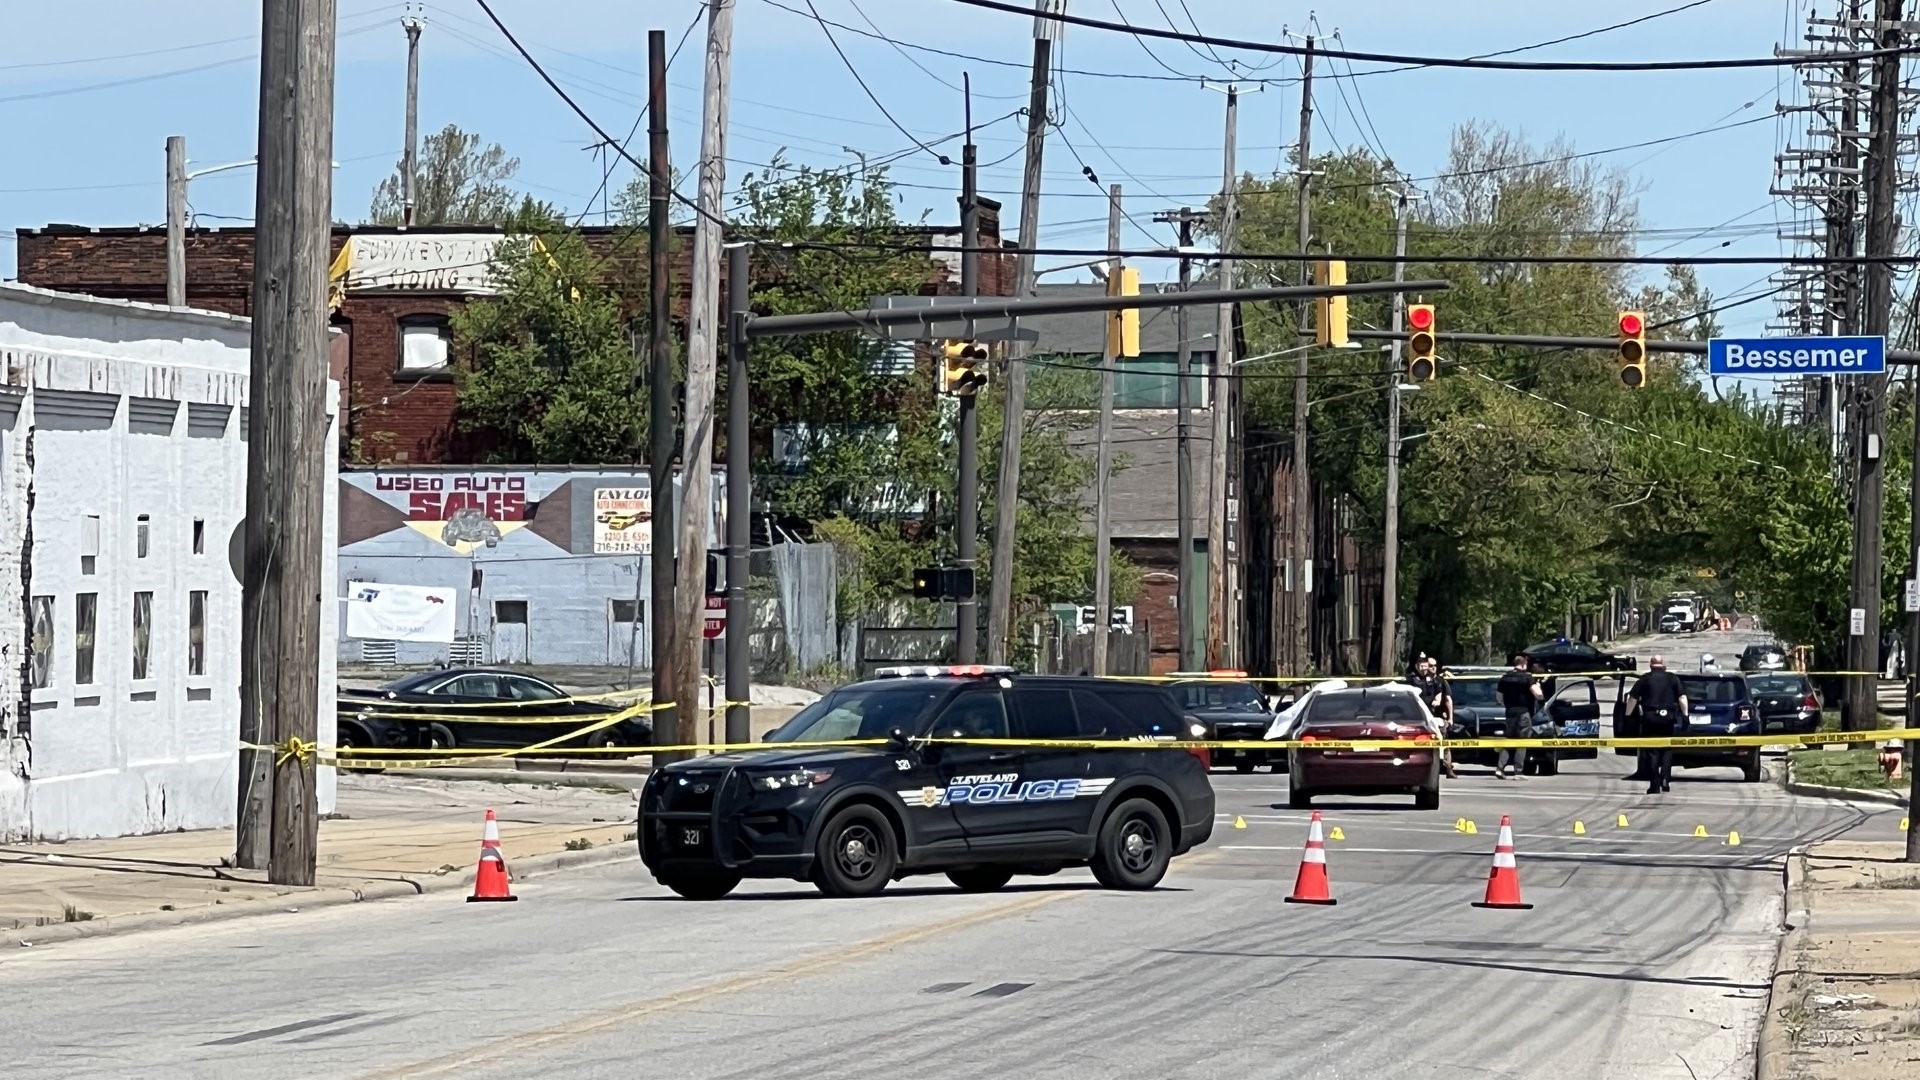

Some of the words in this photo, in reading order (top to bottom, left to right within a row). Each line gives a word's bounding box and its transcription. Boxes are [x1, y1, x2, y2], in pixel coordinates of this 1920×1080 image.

[1726, 344, 1868, 368] Bessemer
[376, 477, 443, 490] USED
[455, 477, 525, 490] AUTO
[410, 493, 525, 520] SALES
[708, 598, 722, 608] NOT
[950, 773, 1018, 785] CLEVELAND
[940, 779, 1083, 806] POLICE
[684, 830, 700, 844] 321
